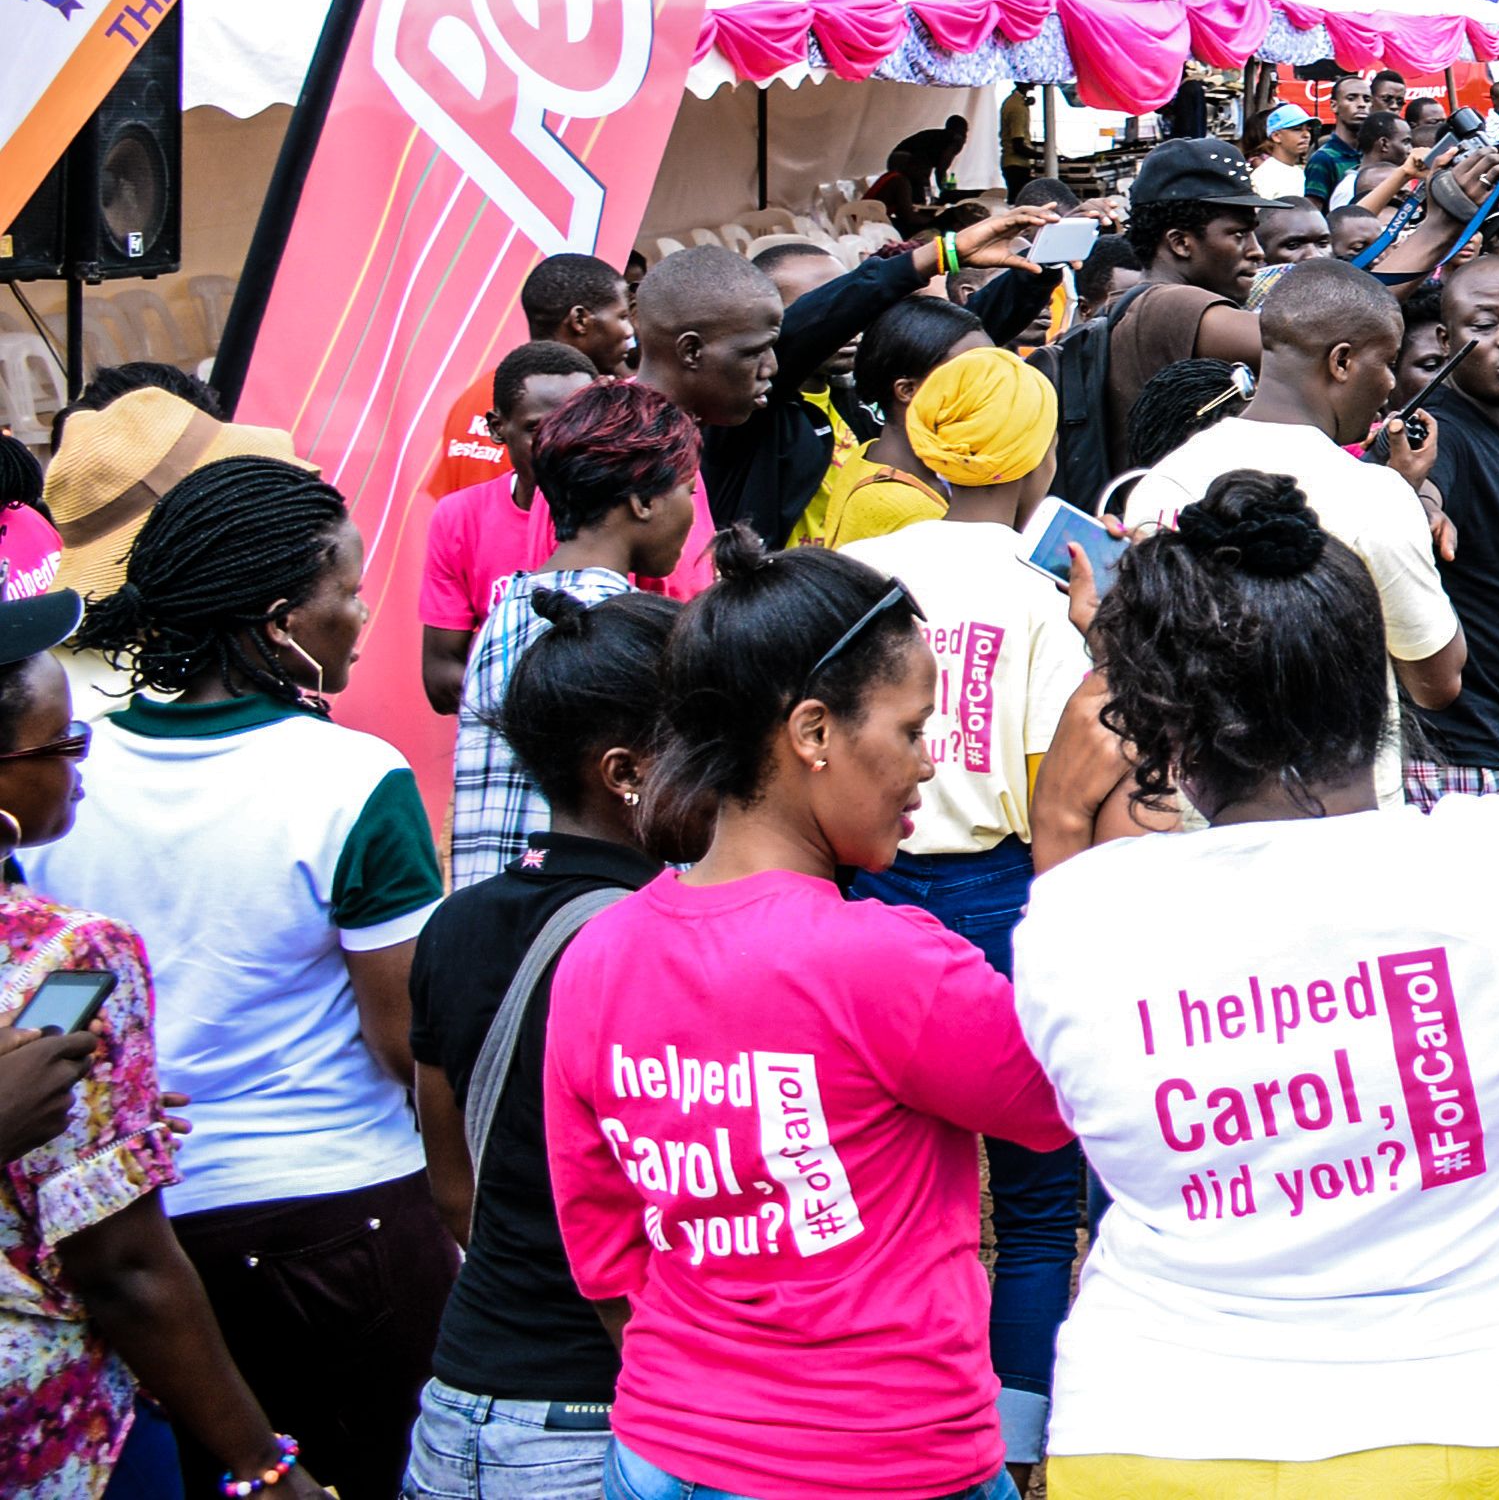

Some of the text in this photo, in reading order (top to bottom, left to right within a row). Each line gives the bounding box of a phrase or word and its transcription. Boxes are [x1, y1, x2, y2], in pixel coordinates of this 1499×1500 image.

[1388, 203, 1413, 236] SONY
[965, 628, 997, 766] #ForCarol
[1137, 960, 1377, 1056] I helped
[612, 1044, 752, 1113] helped
[1154, 1048, 1397, 1153] Carol,
[1393, 960, 1472, 1175] #ForCarol
[769, 1064, 847, 1241] #ForCarol
[1181, 1141, 1407, 1221] did you?
[678, 1201, 786, 1265] you?
